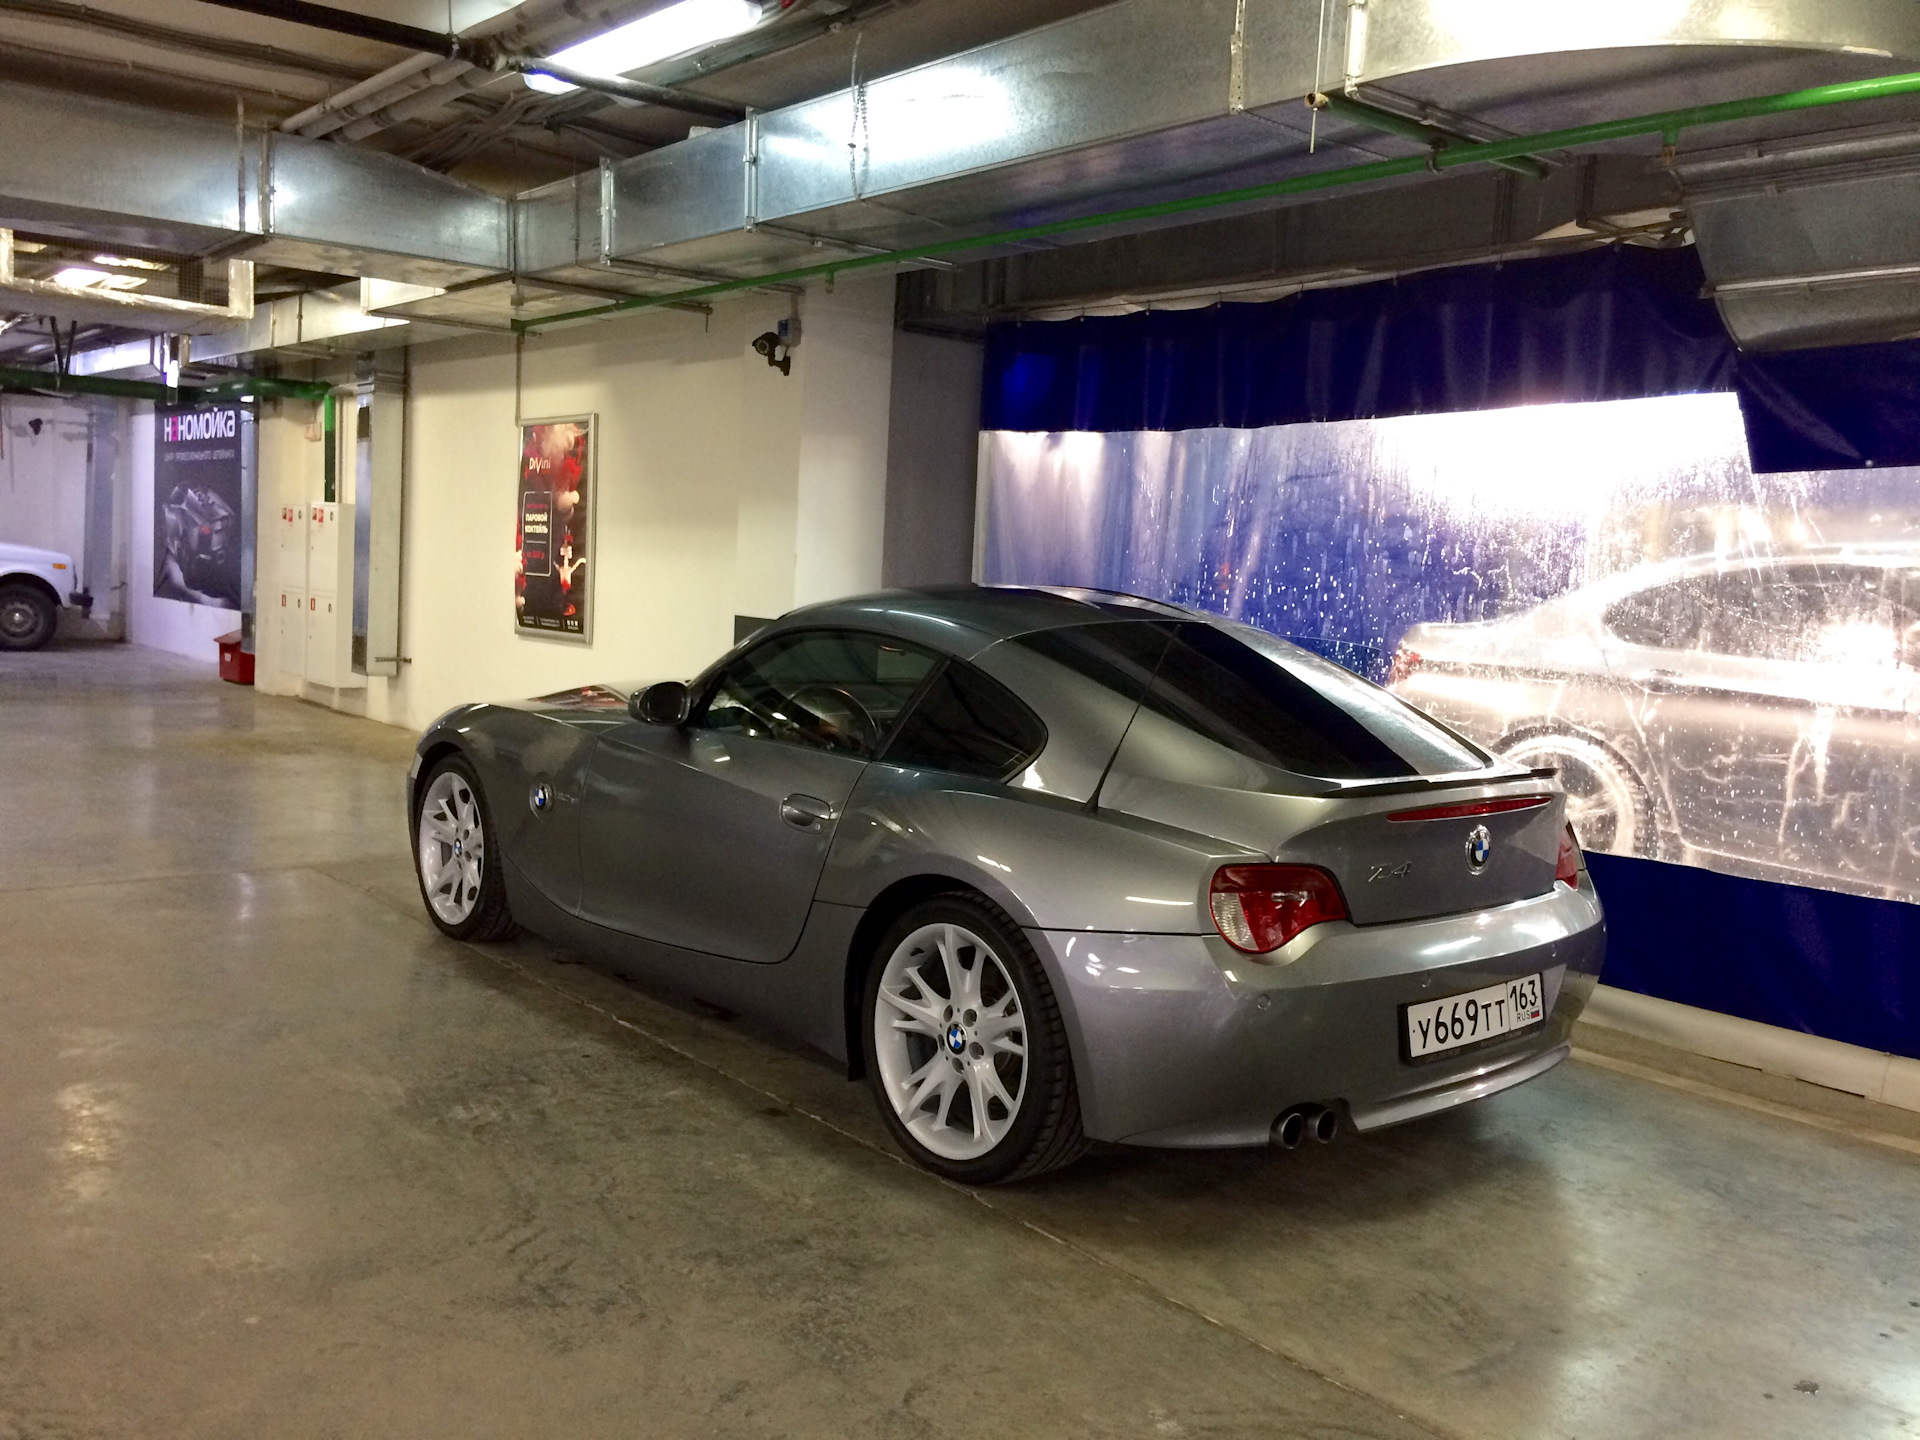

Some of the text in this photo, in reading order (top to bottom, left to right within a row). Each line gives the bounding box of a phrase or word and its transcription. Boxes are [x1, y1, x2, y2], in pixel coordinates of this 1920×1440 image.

[525, 512, 548, 522] ПАРОВОЙ
[525, 523, 548, 534] КОКТЕЙЛЬ
[1368, 861, 1412, 882] Z4
[1510, 980, 1538, 1012] 163
[1517, 1010, 1531, 1023] RUS
